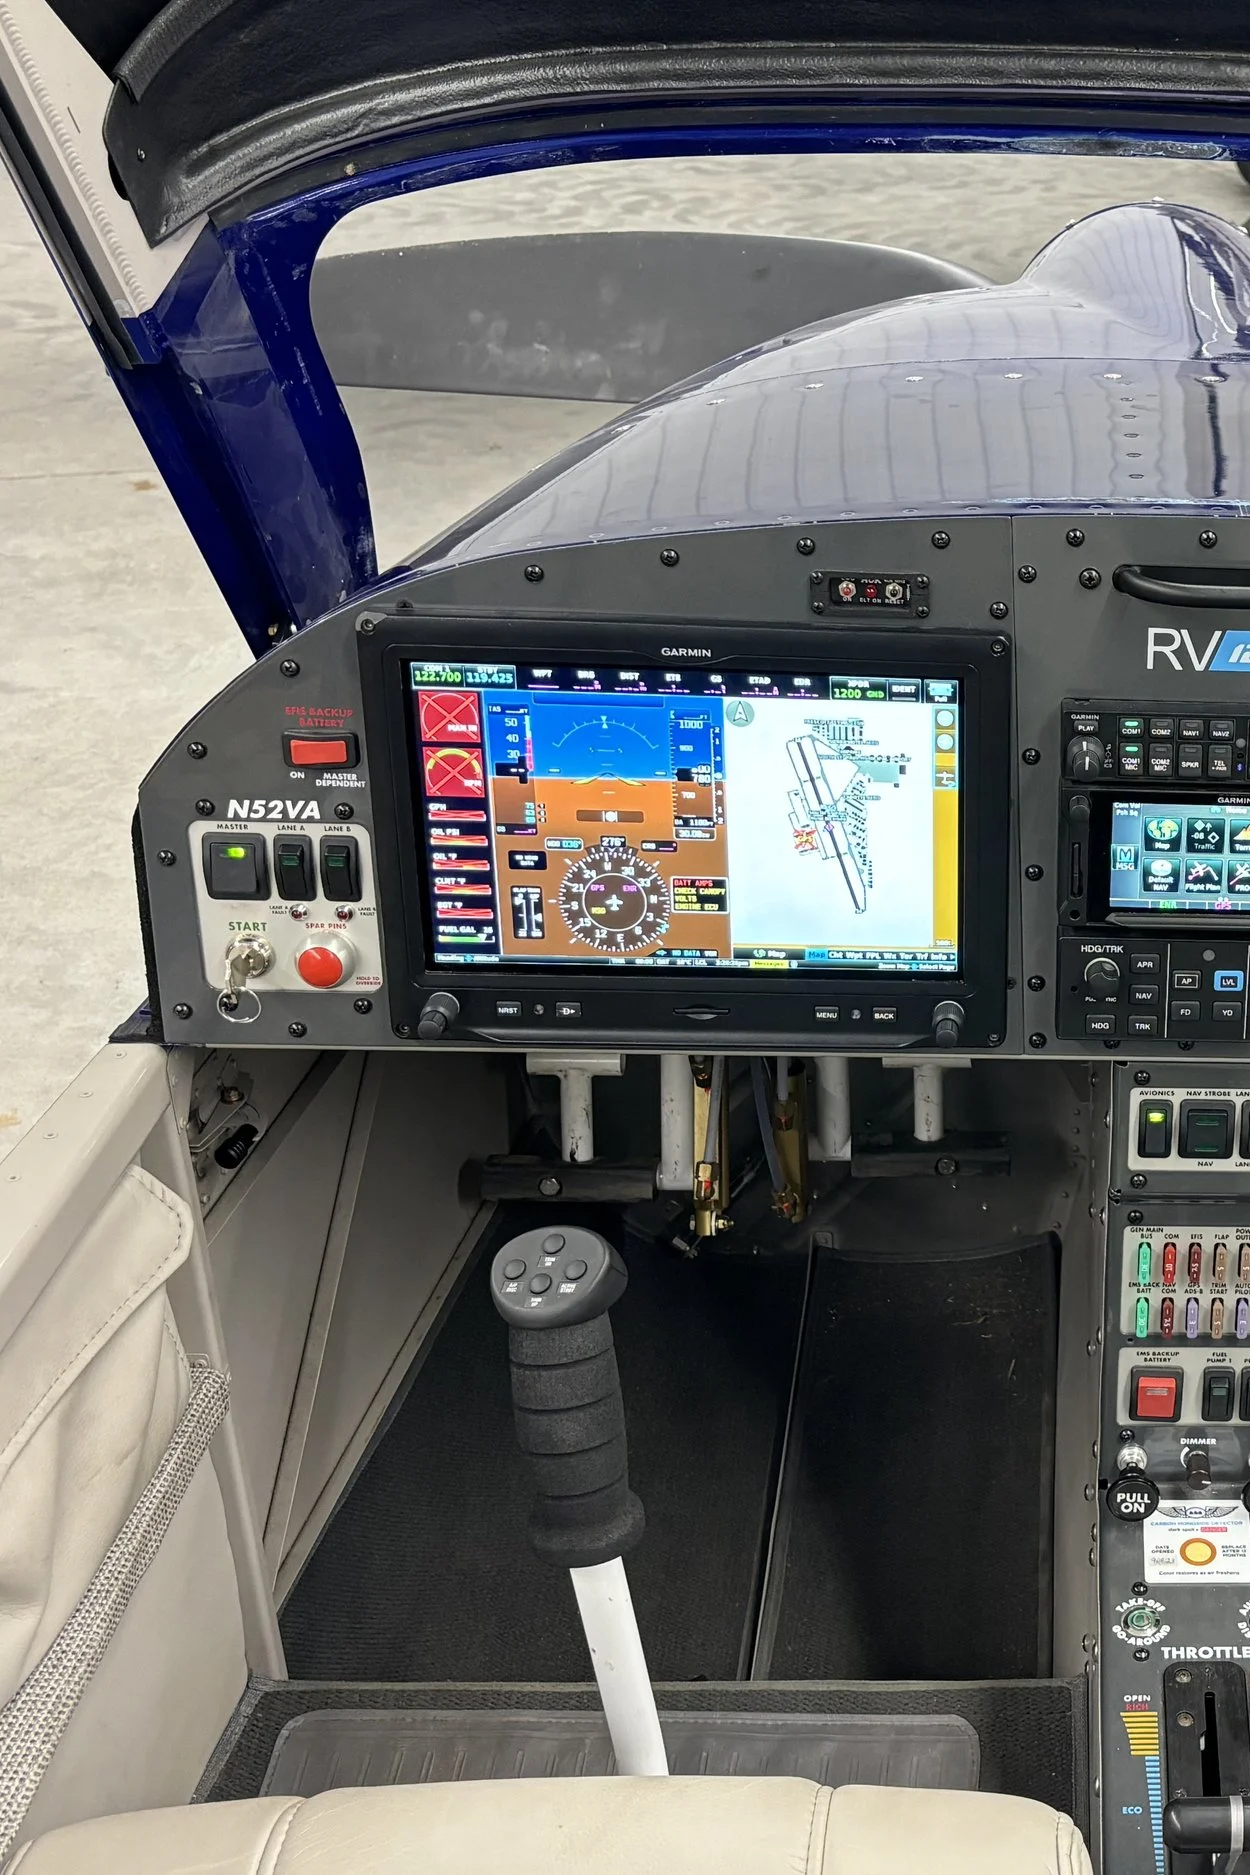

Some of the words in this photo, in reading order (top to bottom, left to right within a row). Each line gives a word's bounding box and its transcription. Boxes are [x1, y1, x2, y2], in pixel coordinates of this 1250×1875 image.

[661, 647, 711, 657] GARMIN
[1147, 627, 1222, 671] RV
[414, 671, 461, 682] 122.700
[466, 672, 513, 683] 119.425
[309, 708, 353, 718] BACKUP
[299, 718, 344, 727] BATTERY
[505, 718, 518, 727] 50
[506, 734, 519, 743] 40
[316, 780, 366, 788] DEPENDENT
[227, 799, 321, 819] N52VA
[229, 922, 267, 932] START
[1081, 945, 1124, 953] HDG/TRK
[816, 1011, 837, 1019] MENU
[874, 1012, 894, 1020] BACK
[1117, 1493, 1151, 1503] PULL
[1121, 1502, 1145, 1513] ON
[1115, 1598, 1166, 1613] TAKE-OFF
[1112, 1624, 1171, 1646] GO-AROUND
[1161, 1647, 1250, 1658] THROTTLE
[1126, 1703, 1149, 1711] RICH
